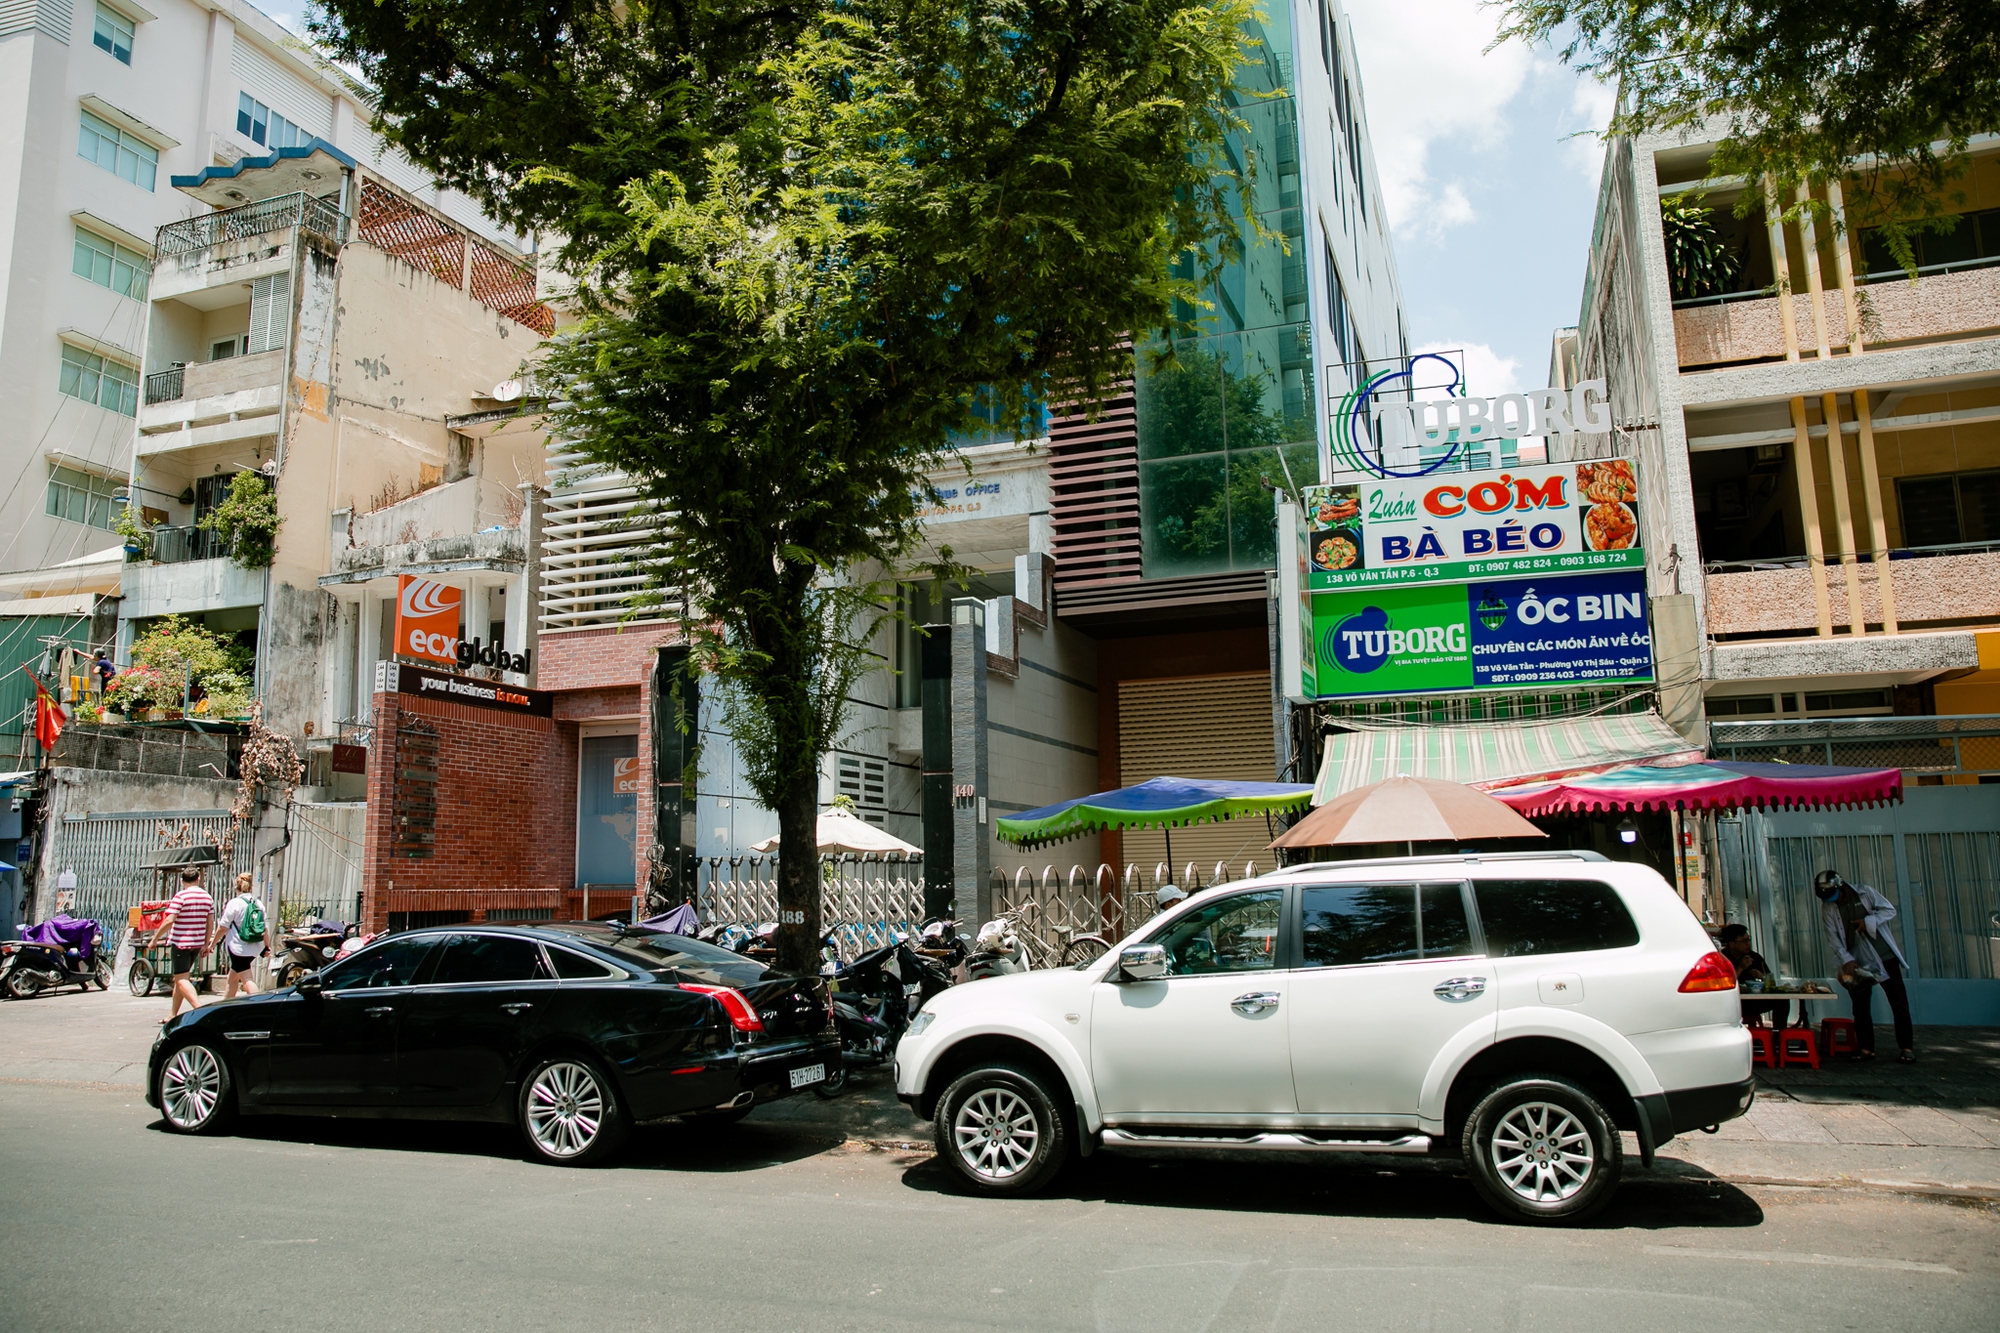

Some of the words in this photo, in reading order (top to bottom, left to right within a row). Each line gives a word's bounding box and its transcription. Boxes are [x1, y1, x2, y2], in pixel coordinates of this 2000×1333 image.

[1370, 377, 1612, 455] TUBORG
[965, 483, 1000, 496] OFFICE
[1368, 489, 1417, 519] Quán
[1422, 474, 1570, 518] CƠM
[1382, 526, 1448, 563] BÀ
[1462, 519, 1565, 557] BÉO
[1326, 574, 1343, 583] 138
[1345, 572, 1358, 582] VÕ
[1401, 569, 1416, 578] P.6
[1423, 567, 1440, 577] Q.3
[1468, 564, 1484, 573] ĐT:
[1486, 562, 1510, 571] 0907
[1512, 560, 1531, 570] 482
[1533, 559, 1551, 568] 824
[1560, 556, 1585, 566] 0903
[1588, 555, 1606, 564] 168
[1609, 553, 1627, 562] 724
[1516, 587, 1571, 625] ỐC
[1577, 592, 1642, 622] BIN
[409, 629, 458, 660] ecx
[456, 636, 532, 674] global
[1342, 623, 1467, 660] TUBORG
[1472, 639, 1525, 655] CHUYÊN
[1526, 638, 1554, 652] CÁC
[1556, 636, 1587, 650] MÓN
[1588, 636, 1609, 648] ĂN
[1610, 632, 1629, 647] VỀ
[1630, 631, 1650, 646] ỐC
[1476, 665, 1489, 673] 138
[1490, 664, 1502, 672] Võ
[1502, 663, 1518, 671] Văn
[1572, 659, 1584, 667] Võ
[1584, 658, 1598, 668] Thị
[1599, 658, 1614, 666] Sáu
[1620, 657, 1642, 666] Quận
[1514, 673, 1538, 681] 0909
[1539, 672, 1556, 680] 236
[1556, 671, 1574, 679] 403
[1581, 669, 1605, 678] 0903
[1618, 668, 1635, 676] 212
[420, 676, 449, 691] your
[448, 678, 496, 699] business
[496, 687, 506, 702] is
[955, 784, 975, 798] 140
[780, 909, 805, 925] 188
